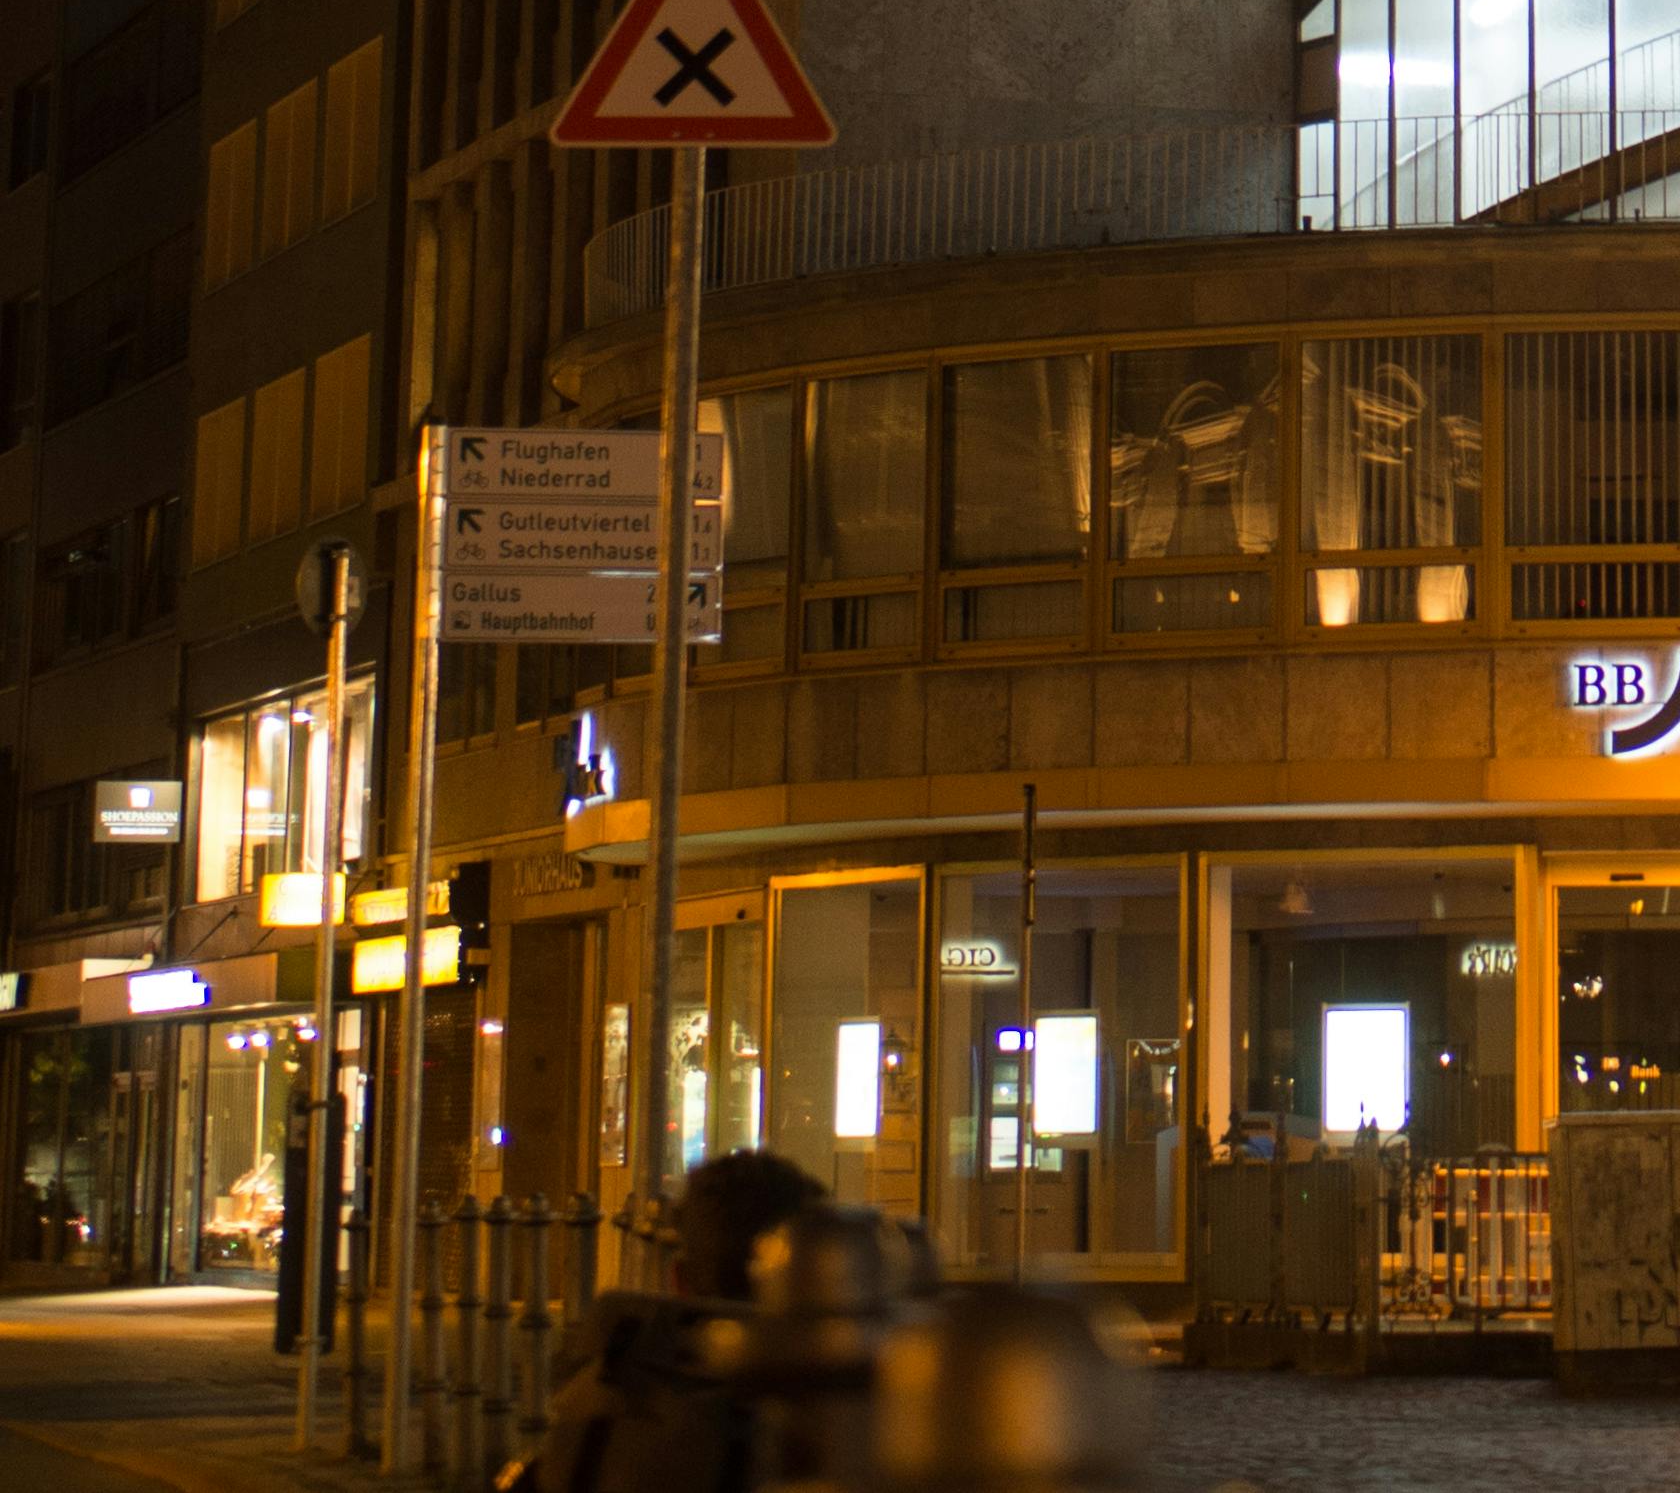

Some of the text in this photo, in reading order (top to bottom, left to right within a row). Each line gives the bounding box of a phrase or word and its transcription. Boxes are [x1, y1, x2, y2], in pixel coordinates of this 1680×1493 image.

[502, 440, 610, 464] Flughafen
[500, 468, 611, 488] Niederrad
[500, 511, 650, 532] Gutleutviertel
[499, 538, 658, 560] Sachsenhause
[452, 582, 521, 603] Gallus
[481, 612, 595, 634] Hauptbahnhof
[1573, 663, 1646, 706] BB
